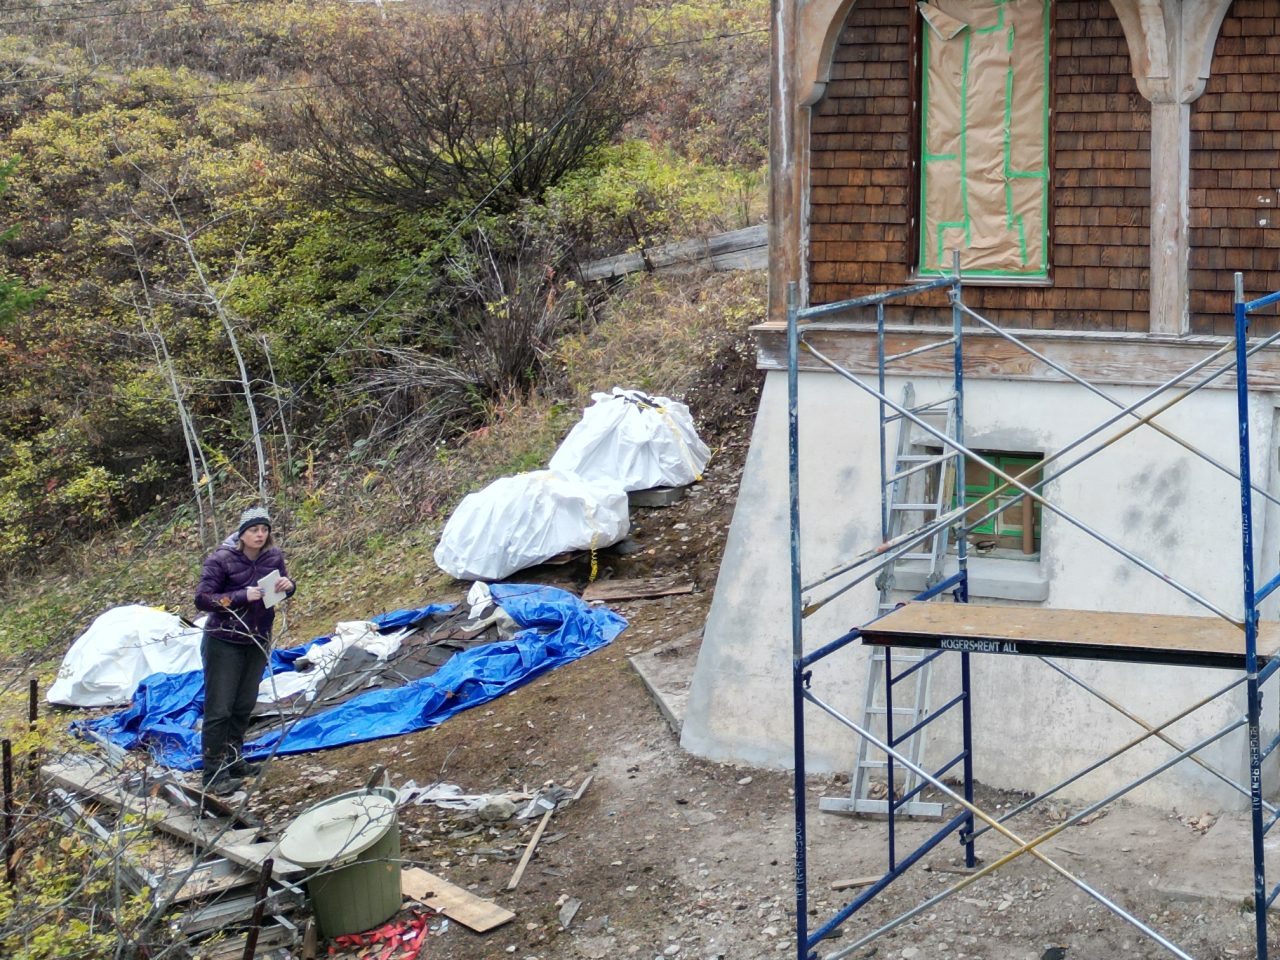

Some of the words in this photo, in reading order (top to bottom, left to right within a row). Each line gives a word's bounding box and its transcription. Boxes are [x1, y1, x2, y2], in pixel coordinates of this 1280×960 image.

[1003, 642, 1019, 653] ALL
[1250, 726, 1260, 766] ROGERS
[1251, 768, 1260, 794] RENT
